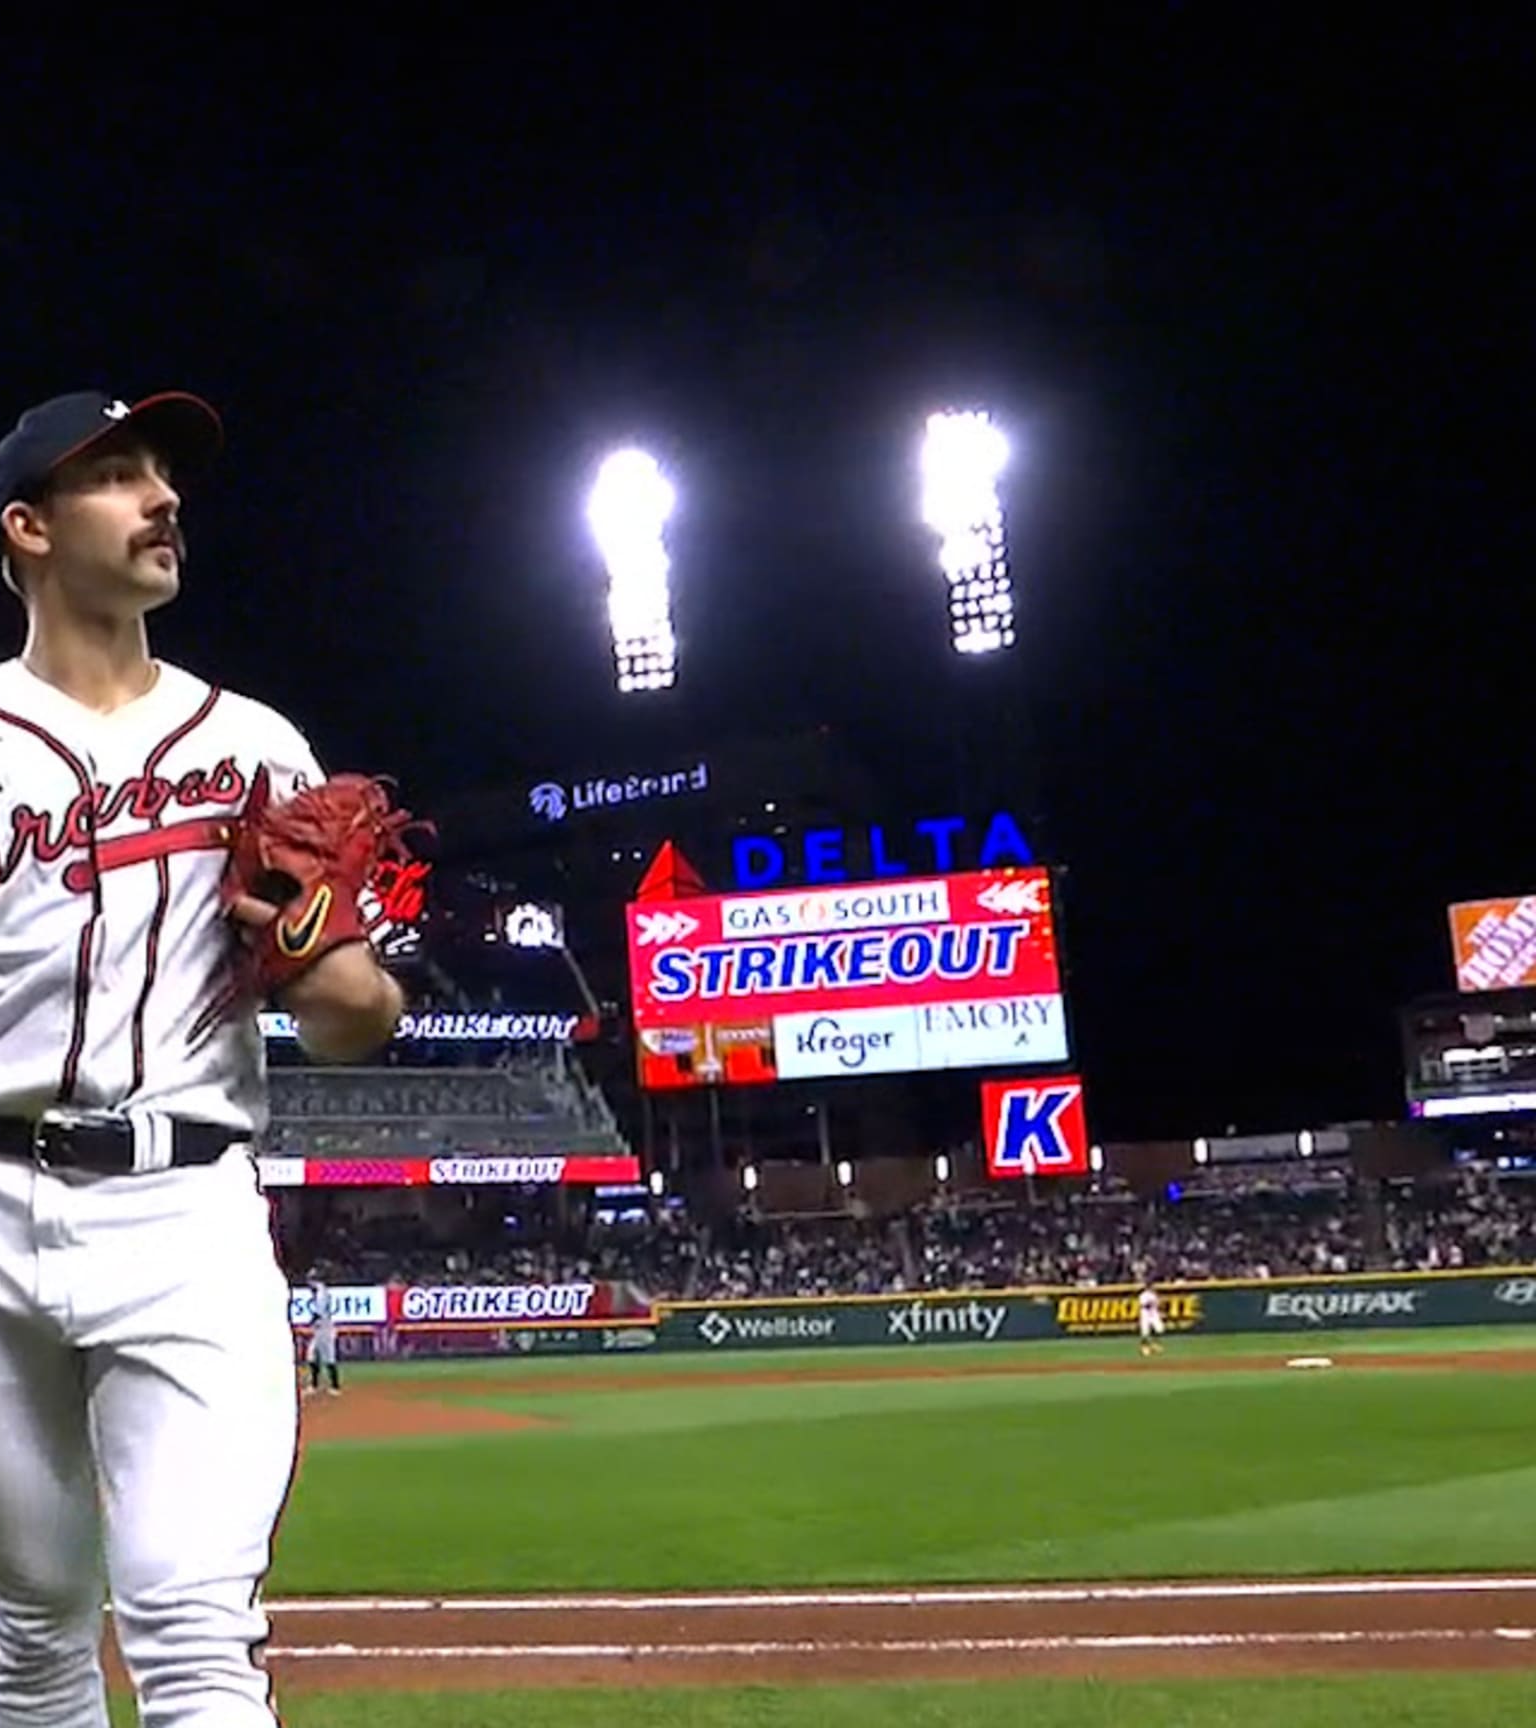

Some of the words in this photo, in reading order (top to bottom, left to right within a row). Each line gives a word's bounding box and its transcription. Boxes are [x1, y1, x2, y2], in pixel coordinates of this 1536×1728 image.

[732, 811, 1033, 890] DELTA
[728, 906, 790, 929] GAS
[834, 891, 938, 920] SOUTH
[651, 922, 1029, 1001] STRIKEOUT
[924, 1000, 1052, 1031] EMORY
[797, 1017, 894, 1068] Kroger
[995, 1085, 1081, 1168] K
[403, 1284, 594, 1320] STRIKEOUT
[888, 1300, 1006, 1341] xfinity
[1057, 1293, 1202, 1321] QUIKTE
[1267, 1290, 1418, 1324] EQUIFAX
[734, 1318, 835, 1338] Wellstar
